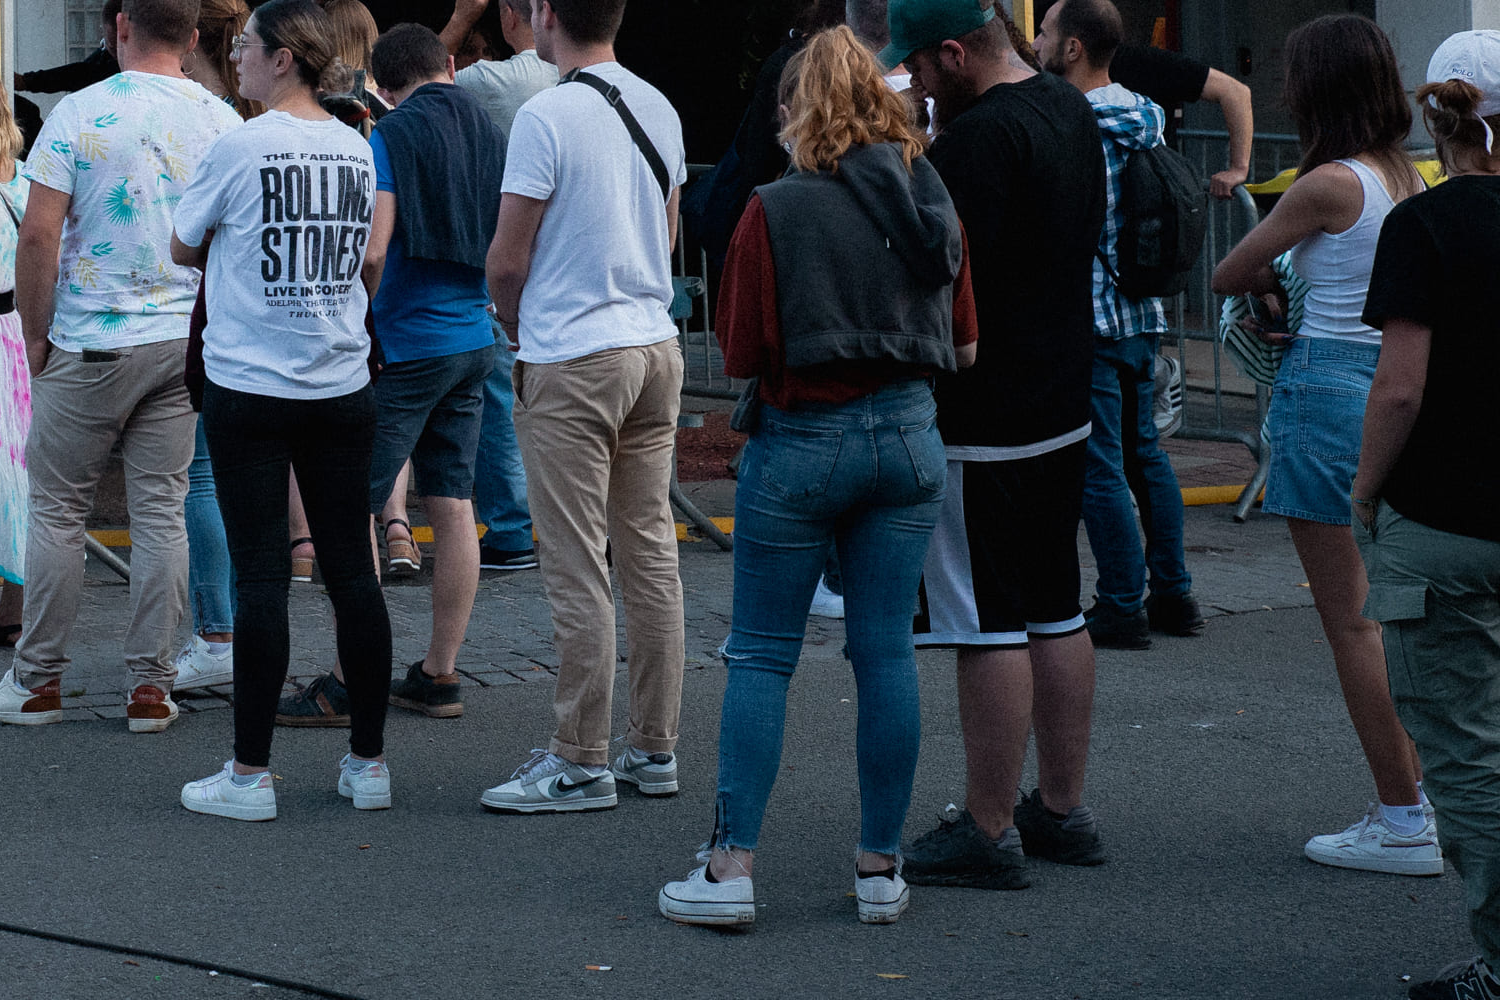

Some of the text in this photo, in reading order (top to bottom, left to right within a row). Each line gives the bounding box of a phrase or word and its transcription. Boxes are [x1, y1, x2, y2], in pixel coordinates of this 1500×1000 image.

[263, 152, 369, 166] THE FABULOUS
[260, 165, 373, 225] ROLLING
[261, 224, 367, 283] STONES
[265, 286, 297, 297] LIVE
[300, 286, 313, 297] IN
